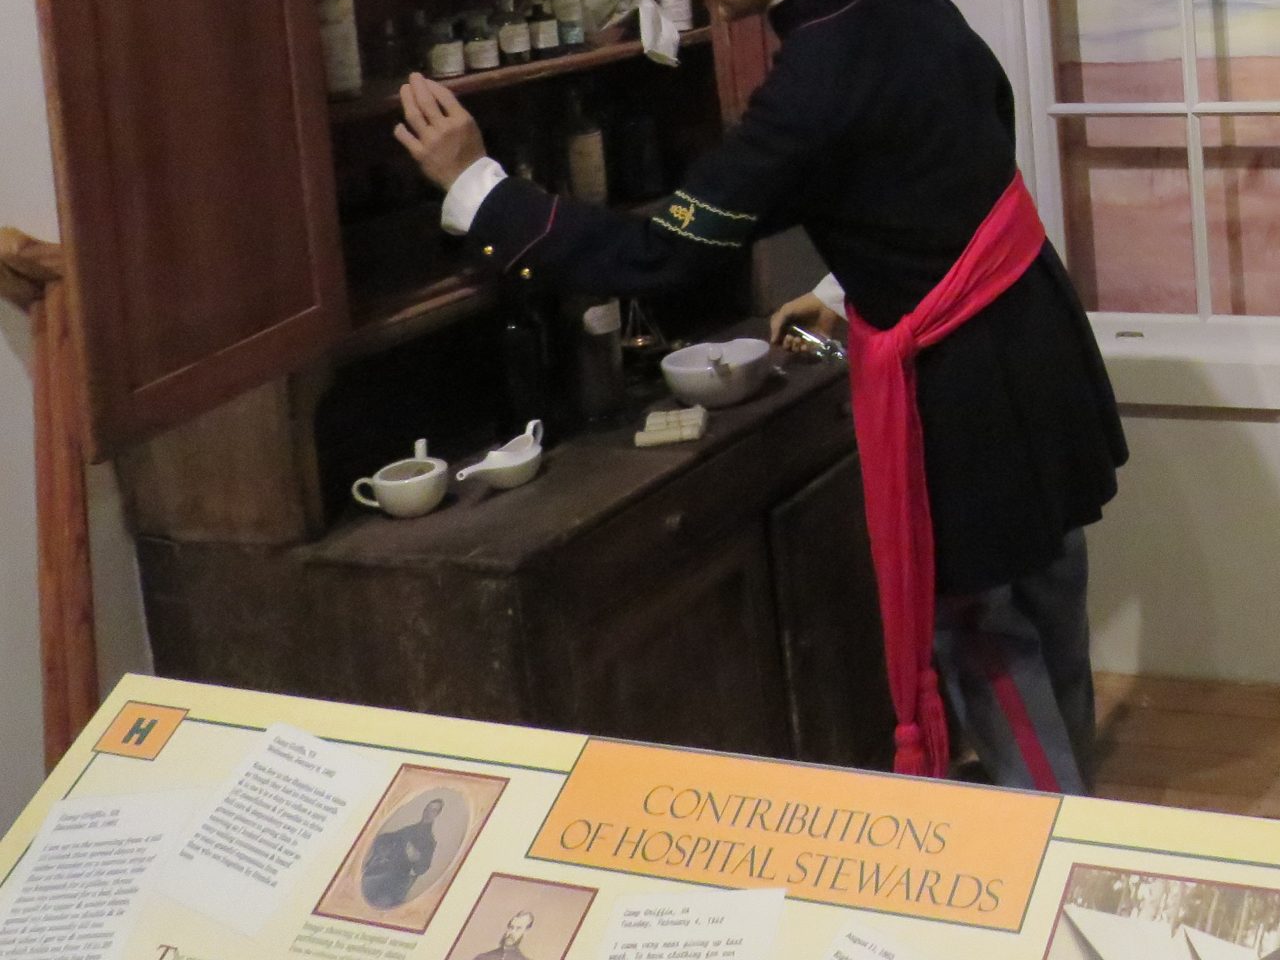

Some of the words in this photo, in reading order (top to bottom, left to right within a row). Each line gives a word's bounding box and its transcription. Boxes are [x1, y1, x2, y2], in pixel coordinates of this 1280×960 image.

[121, 717, 158, 746] H
[642, 784, 951, 855] CONTRIBUTIONS
[560, 819, 614, 852] OF
[612, 826, 776, 880] HOSPITAL
[786, 851, 1004, 913] STEWARDS
